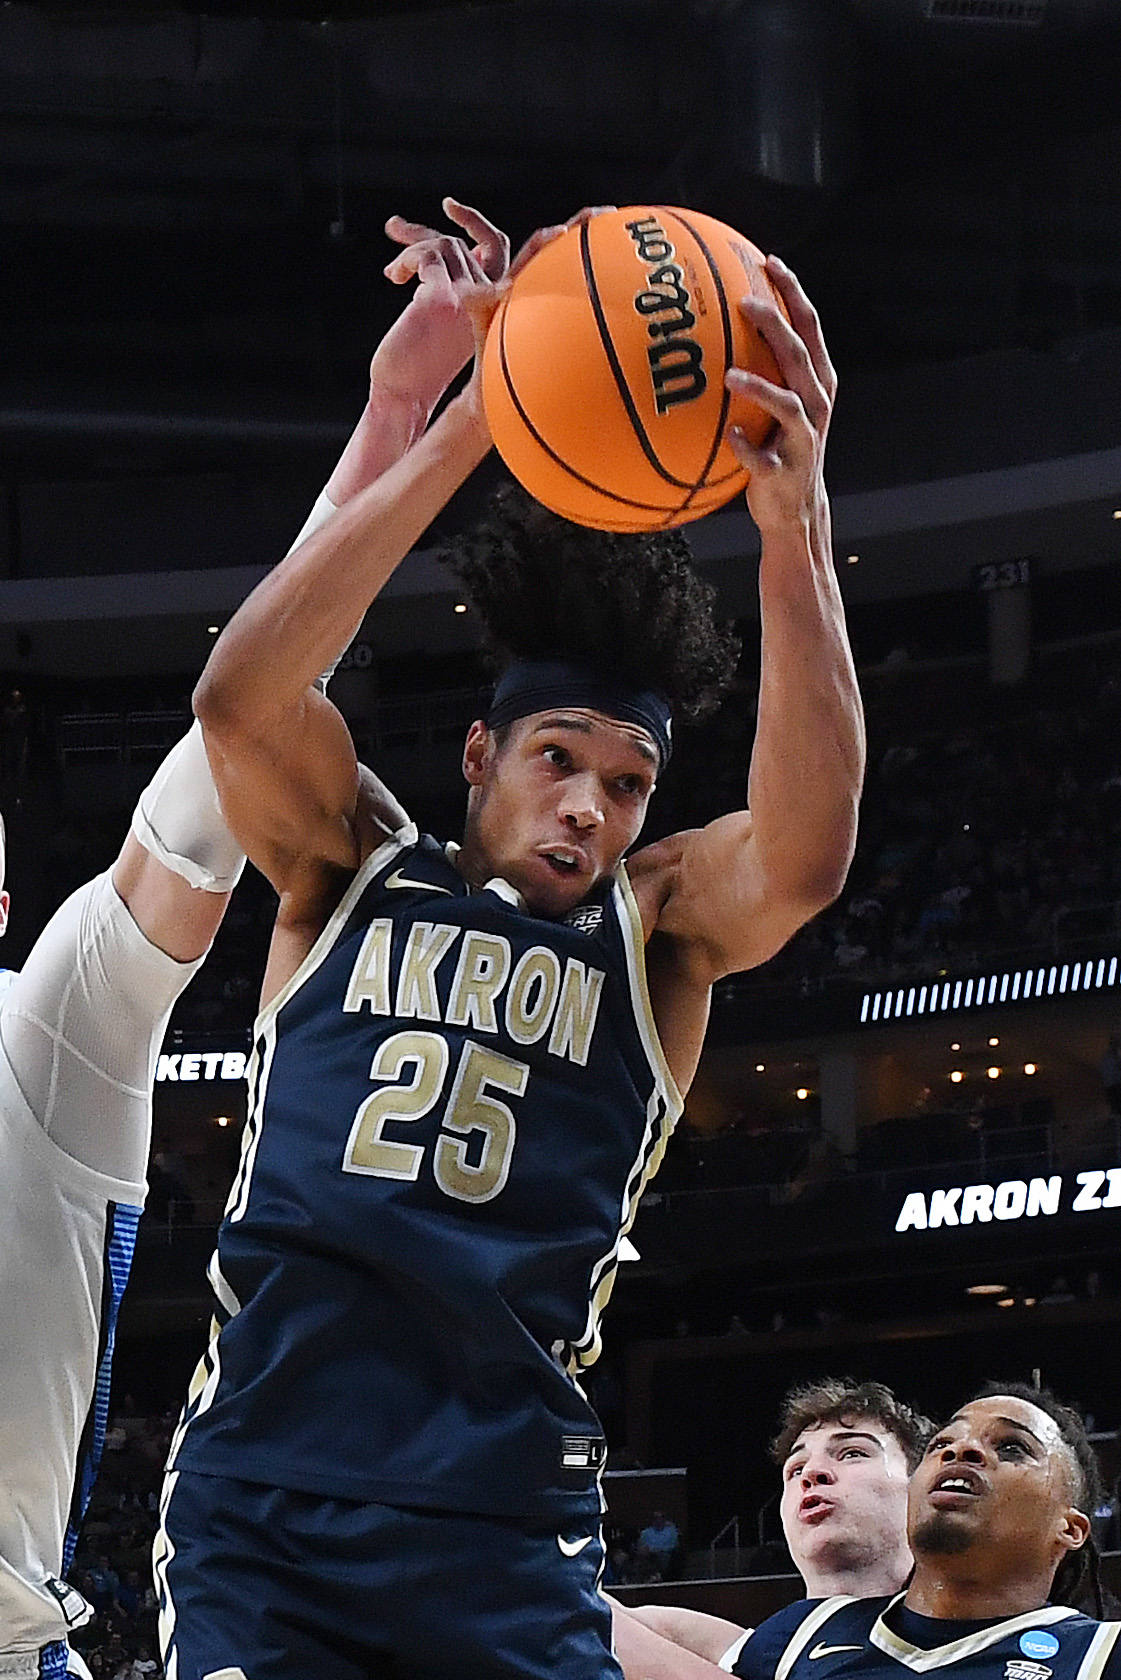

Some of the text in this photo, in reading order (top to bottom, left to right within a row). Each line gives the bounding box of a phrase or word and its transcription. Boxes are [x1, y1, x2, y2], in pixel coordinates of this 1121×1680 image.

[624, 215, 707, 416] Wilson
[342, 918, 607, 1067] AKRON
[341, 1030, 530, 1204] 25
[895, 1175, 1062, 1232] AKRON
